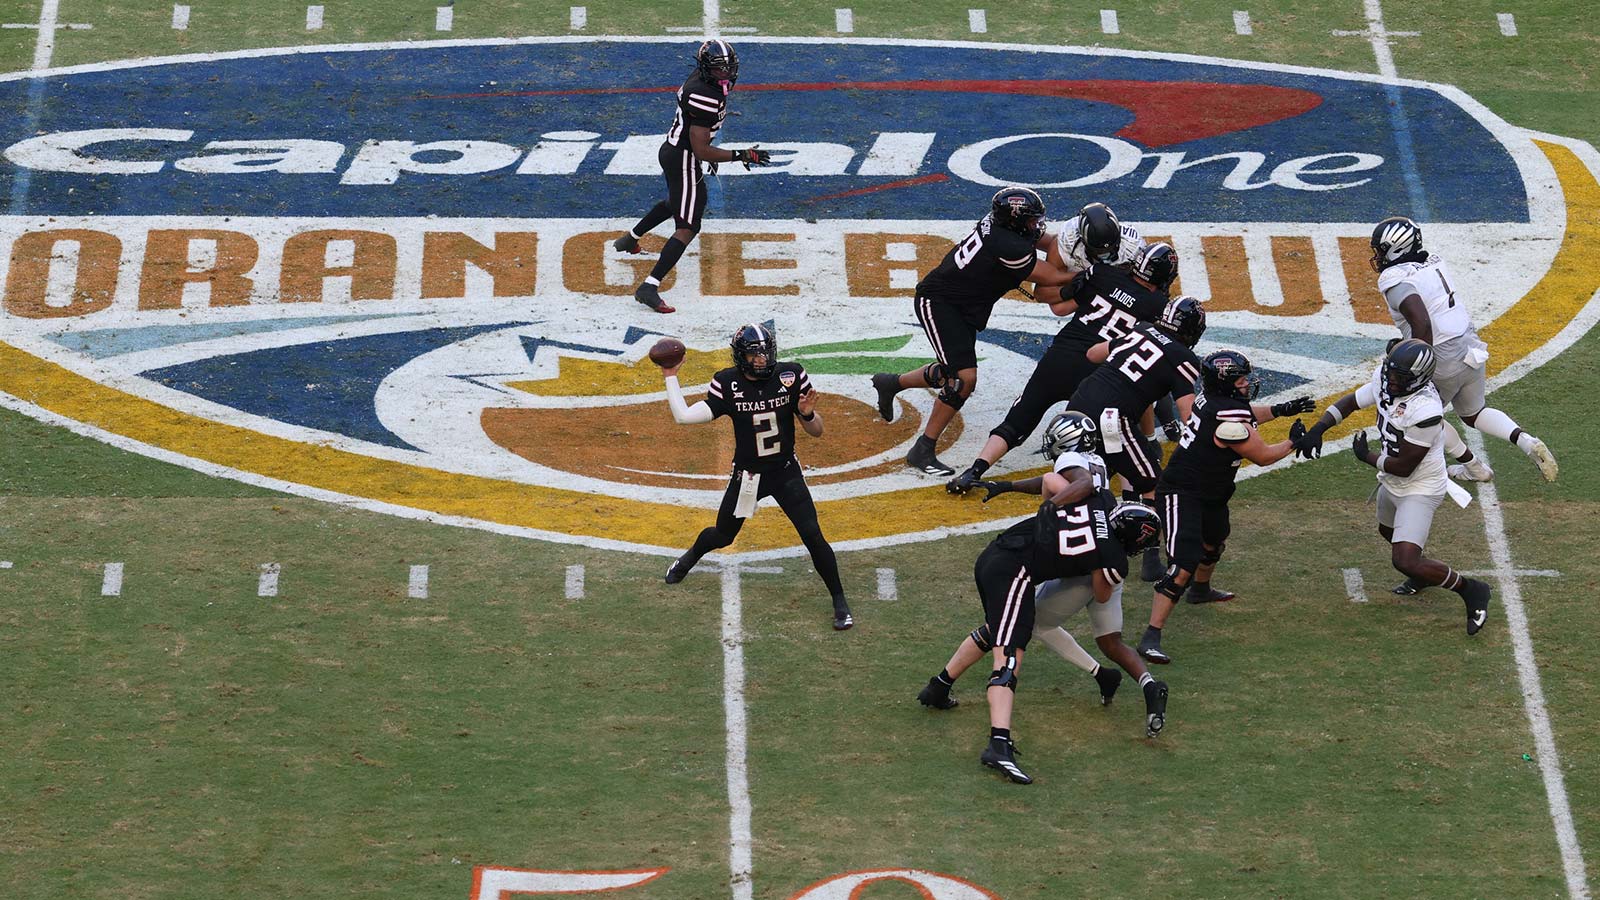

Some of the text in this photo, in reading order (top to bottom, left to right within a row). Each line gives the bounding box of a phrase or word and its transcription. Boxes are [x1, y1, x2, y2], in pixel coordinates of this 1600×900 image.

[3, 127, 1385, 191] Capital One
[3, 228, 800, 319] ORANGE
[1078, 294, 1137, 342] 76
[1109, 287, 1136, 309] JADOS
[1105, 330, 1164, 383] 72
[731, 381, 738, 391] C
[735, 395, 790, 412] TEXAS TECH
[752, 411, 781, 457] 2
[1056, 504, 1097, 556] 70
